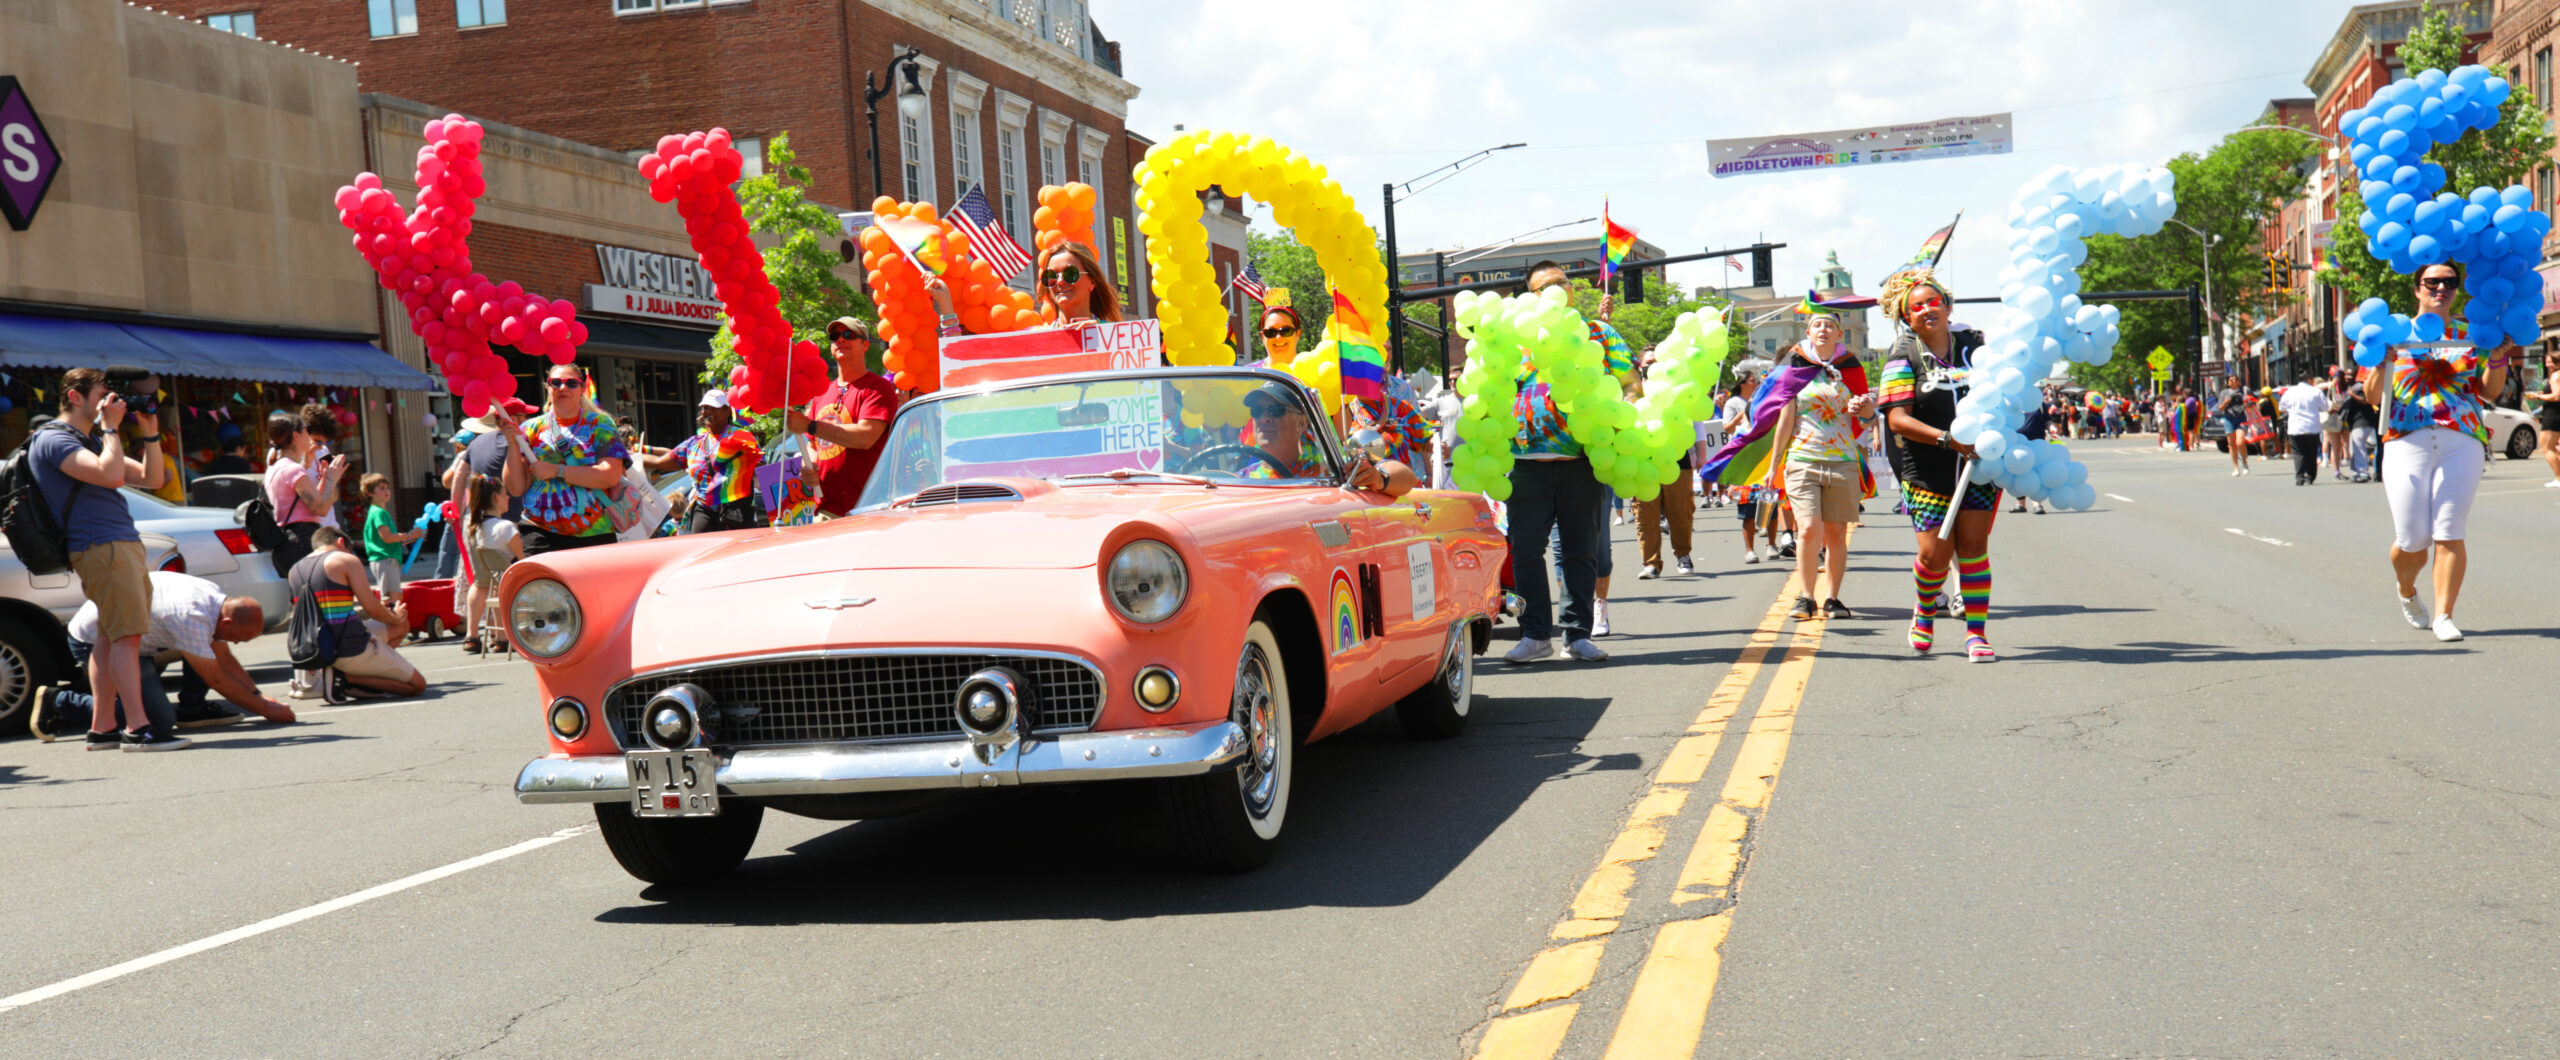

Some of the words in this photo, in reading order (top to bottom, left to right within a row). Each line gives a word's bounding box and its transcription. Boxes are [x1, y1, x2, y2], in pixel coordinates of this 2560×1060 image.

[1890, 124, 1931, 133] Saturday,
[1934, 120, 1956, 129] June
[1969, 117, 1992, 126] 2022
[1904, 137, 1924, 146] 2:00
[1933, 135, 1957, 144] 10:00
[1959, 133, 1973, 141] PM
[2, 122, 40, 183] S
[595, 243, 718, 301] WESLEY
[625, 294, 634, 311] R
[636, 296, 643, 312] J
[646, 297, 675, 316] JULIA
[675, 301, 726, 322] BOOKSTO
[1084, 320, 1156, 353] EVERY
[1083, 395, 1161, 427] COME
[1103, 422, 1161, 452] HERE
[633, 759, 650, 781] W
[665, 754, 697, 790] 15
[638, 787, 653, 810] E
[690, 795, 711, 809] CT
